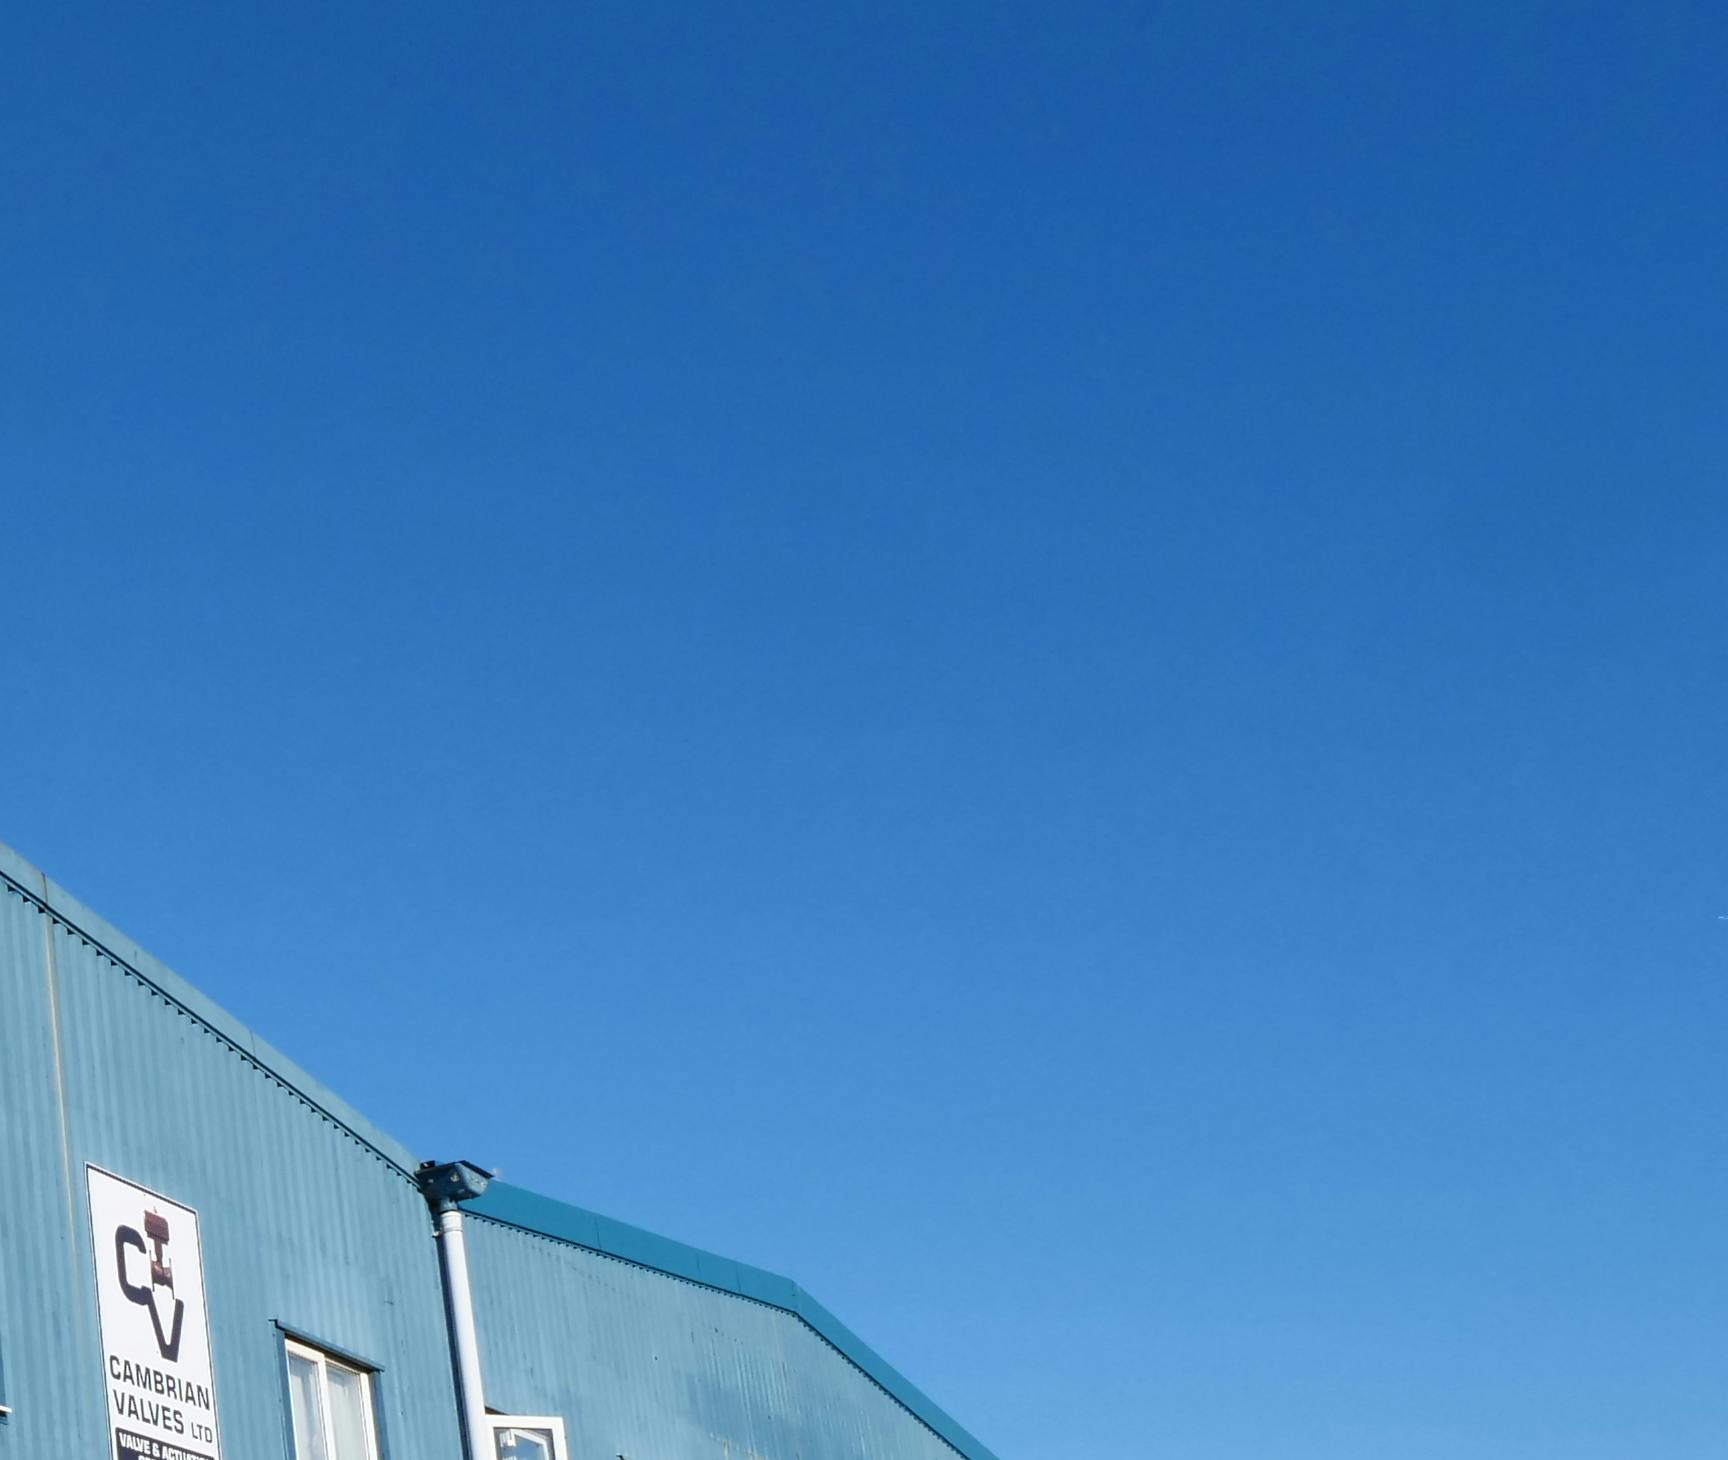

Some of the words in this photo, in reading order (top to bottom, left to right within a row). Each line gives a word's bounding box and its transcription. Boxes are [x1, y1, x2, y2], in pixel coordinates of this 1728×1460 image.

[109, 1355, 210, 1411] CAMBRIAN
[112, 1389, 185, 1435] VALVES
[191, 1422, 213, 1443] LTD
[118, 1432, 151, 1454] VALVE
[151, 1443, 161, 1457] &
